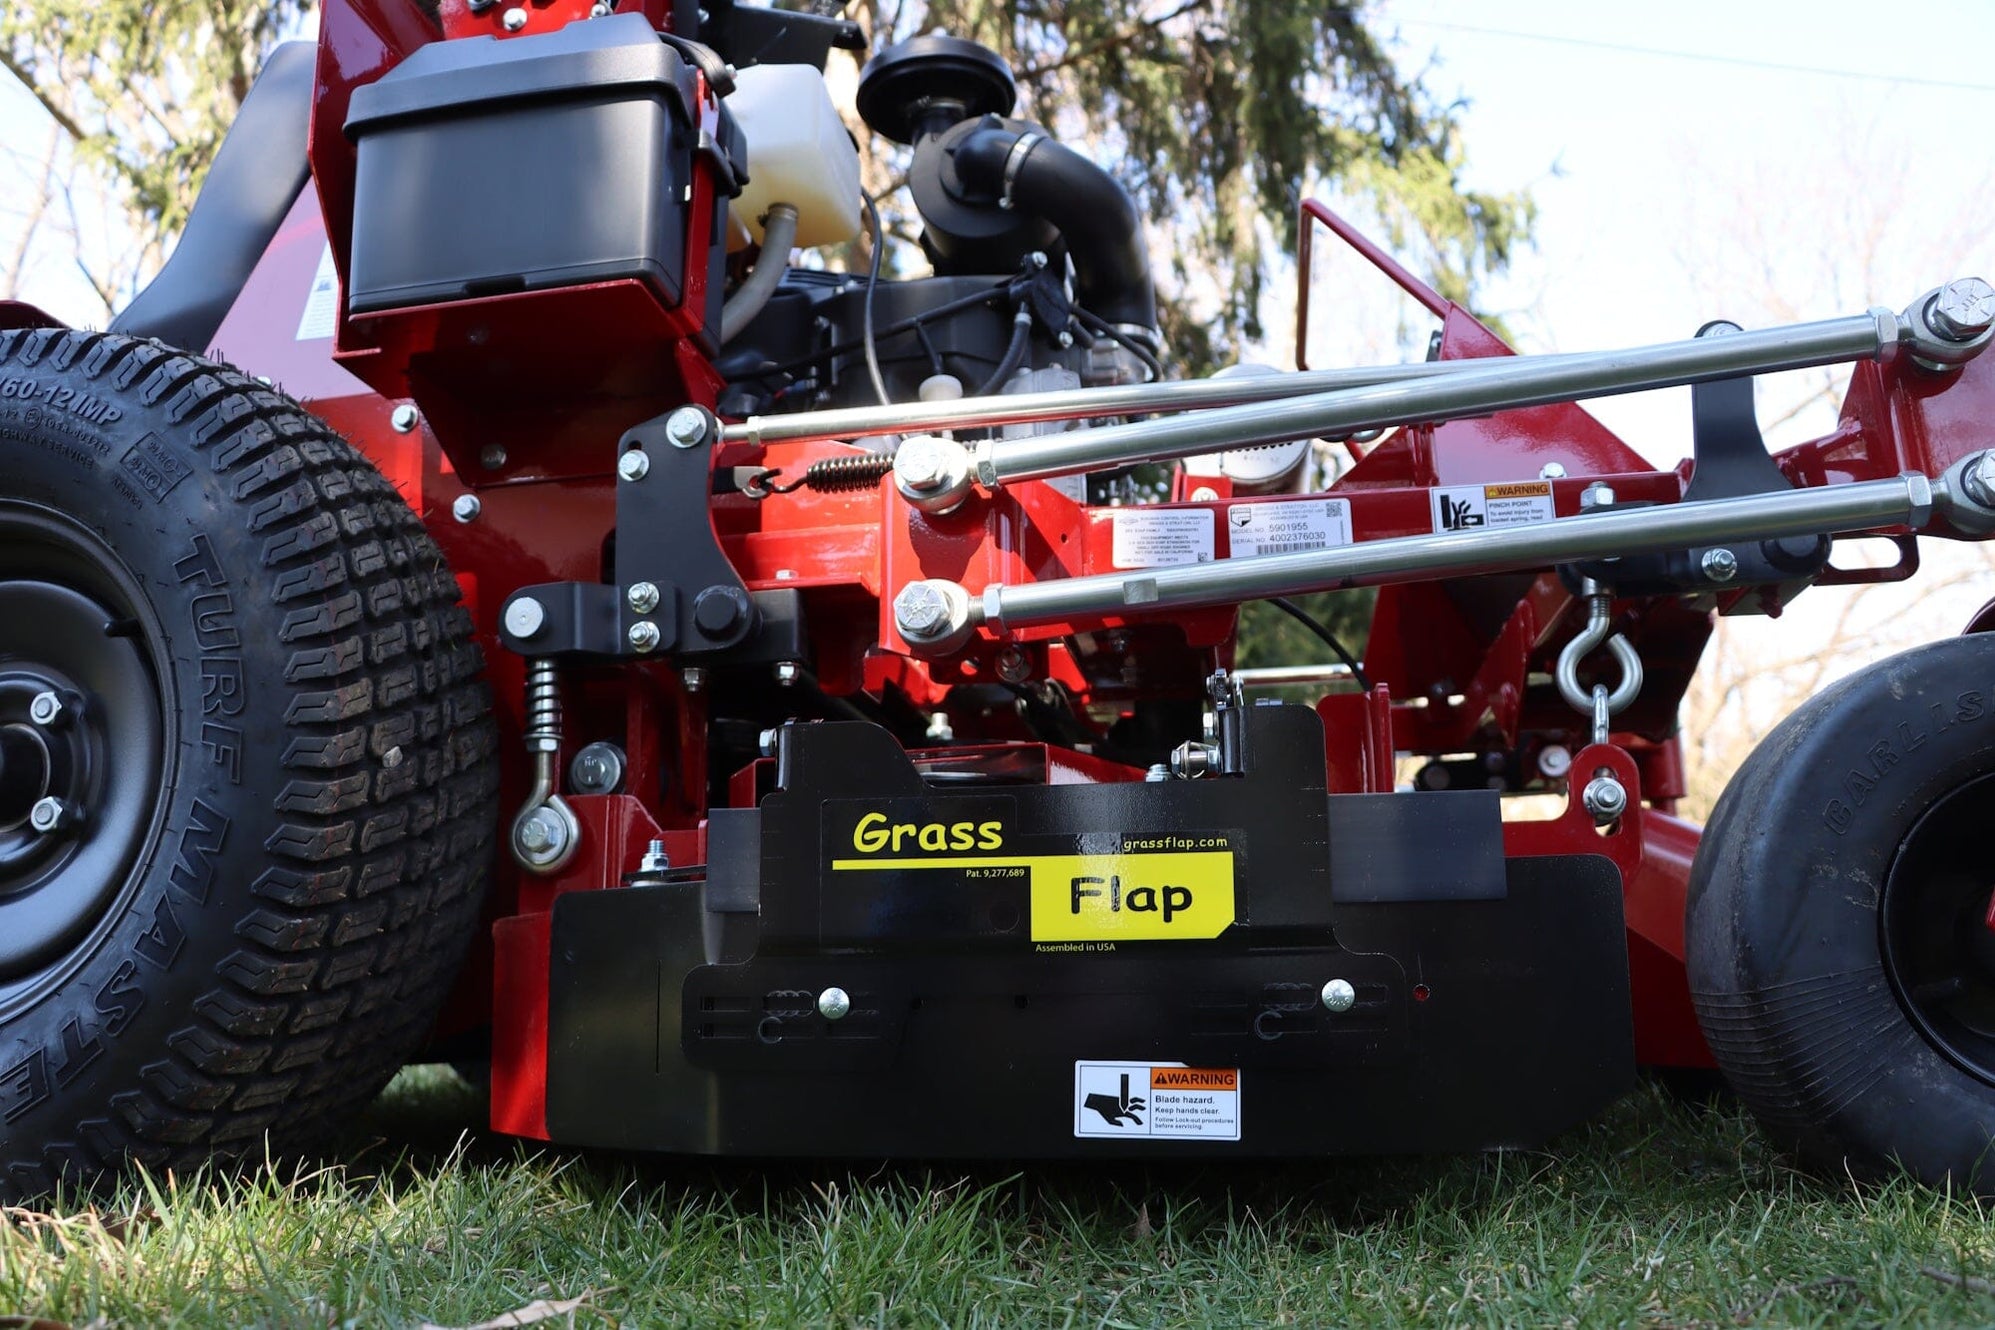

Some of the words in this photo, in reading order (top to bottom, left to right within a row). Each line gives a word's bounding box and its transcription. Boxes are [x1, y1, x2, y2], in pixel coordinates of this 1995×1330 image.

[69, 391, 123, 425] IMP
[1497, 484, 1549, 495] WARNING
[1269, 522, 1309, 532] 5901955
[1269, 531, 1326, 542] 4002376030
[173, 533, 244, 784] TURF
[1823, 685, 1995, 835] CARLIS
[853, 812, 1003, 853] Grass
[1123, 836, 1228, 852] grassflap.com
[965, 869, 982, 878] Pat.
[983, 868, 1025, 879] 9,277,689
[1071, 875, 1193, 923] Flap
[1035, 942, 1084, 953] Assembled
[1086, 942, 1095, 952] in
[1096, 942, 1116, 952] USA
[0, 797, 230, 1124] MASTE
[1167, 1073, 1235, 1085] WARNING
[1155, 1094, 1180, 1103] Blade
[1182, 1095, 1215, 1104] hazard.
[1155, 1106, 1174, 1114] Keep
[1200, 1107, 1221, 1115] clear.
